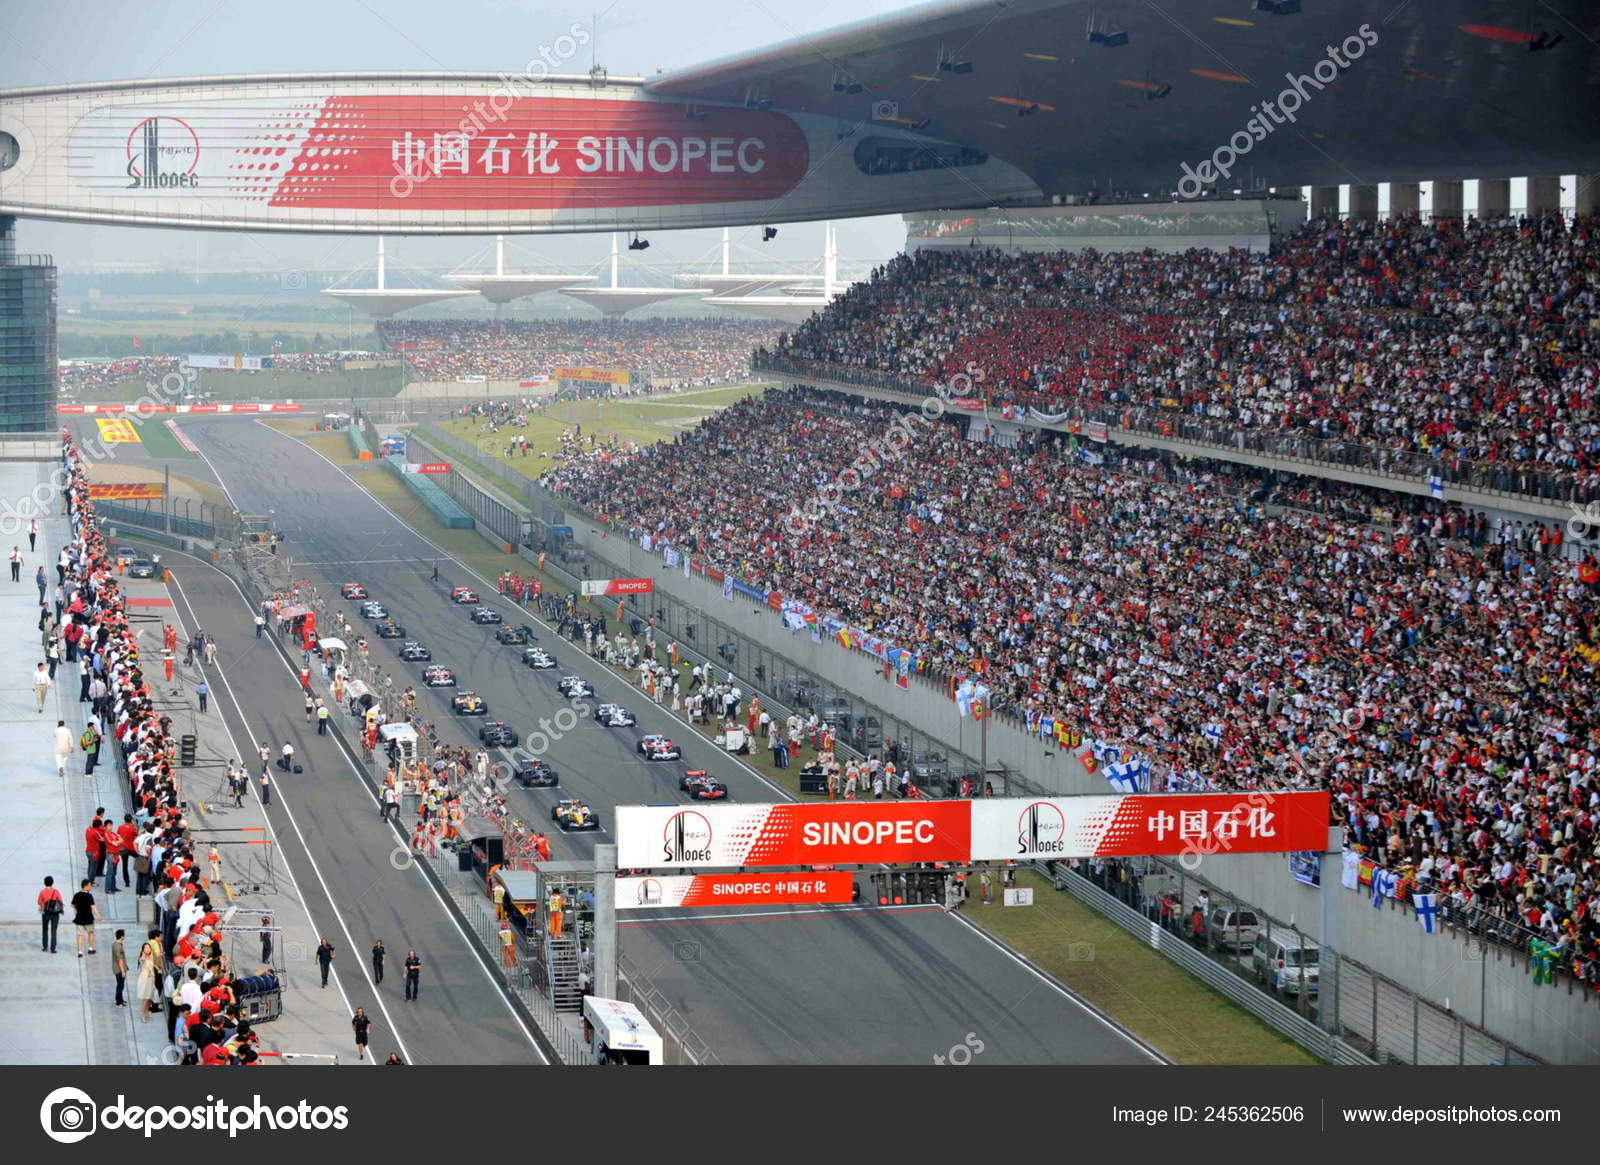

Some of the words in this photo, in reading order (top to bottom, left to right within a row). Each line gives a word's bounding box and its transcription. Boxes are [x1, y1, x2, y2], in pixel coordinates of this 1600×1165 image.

[391, 132, 560, 174] 中国石化
[575, 136, 766, 173] SINOPEC
[618, 582, 648, 590] SINOPEC
[802, 819, 935, 846] SINOPEC
[1147, 807, 1276, 842] 中国石化
[712, 883, 771, 895] SINOPEC
[775, 880, 827, 895] 中国石化
